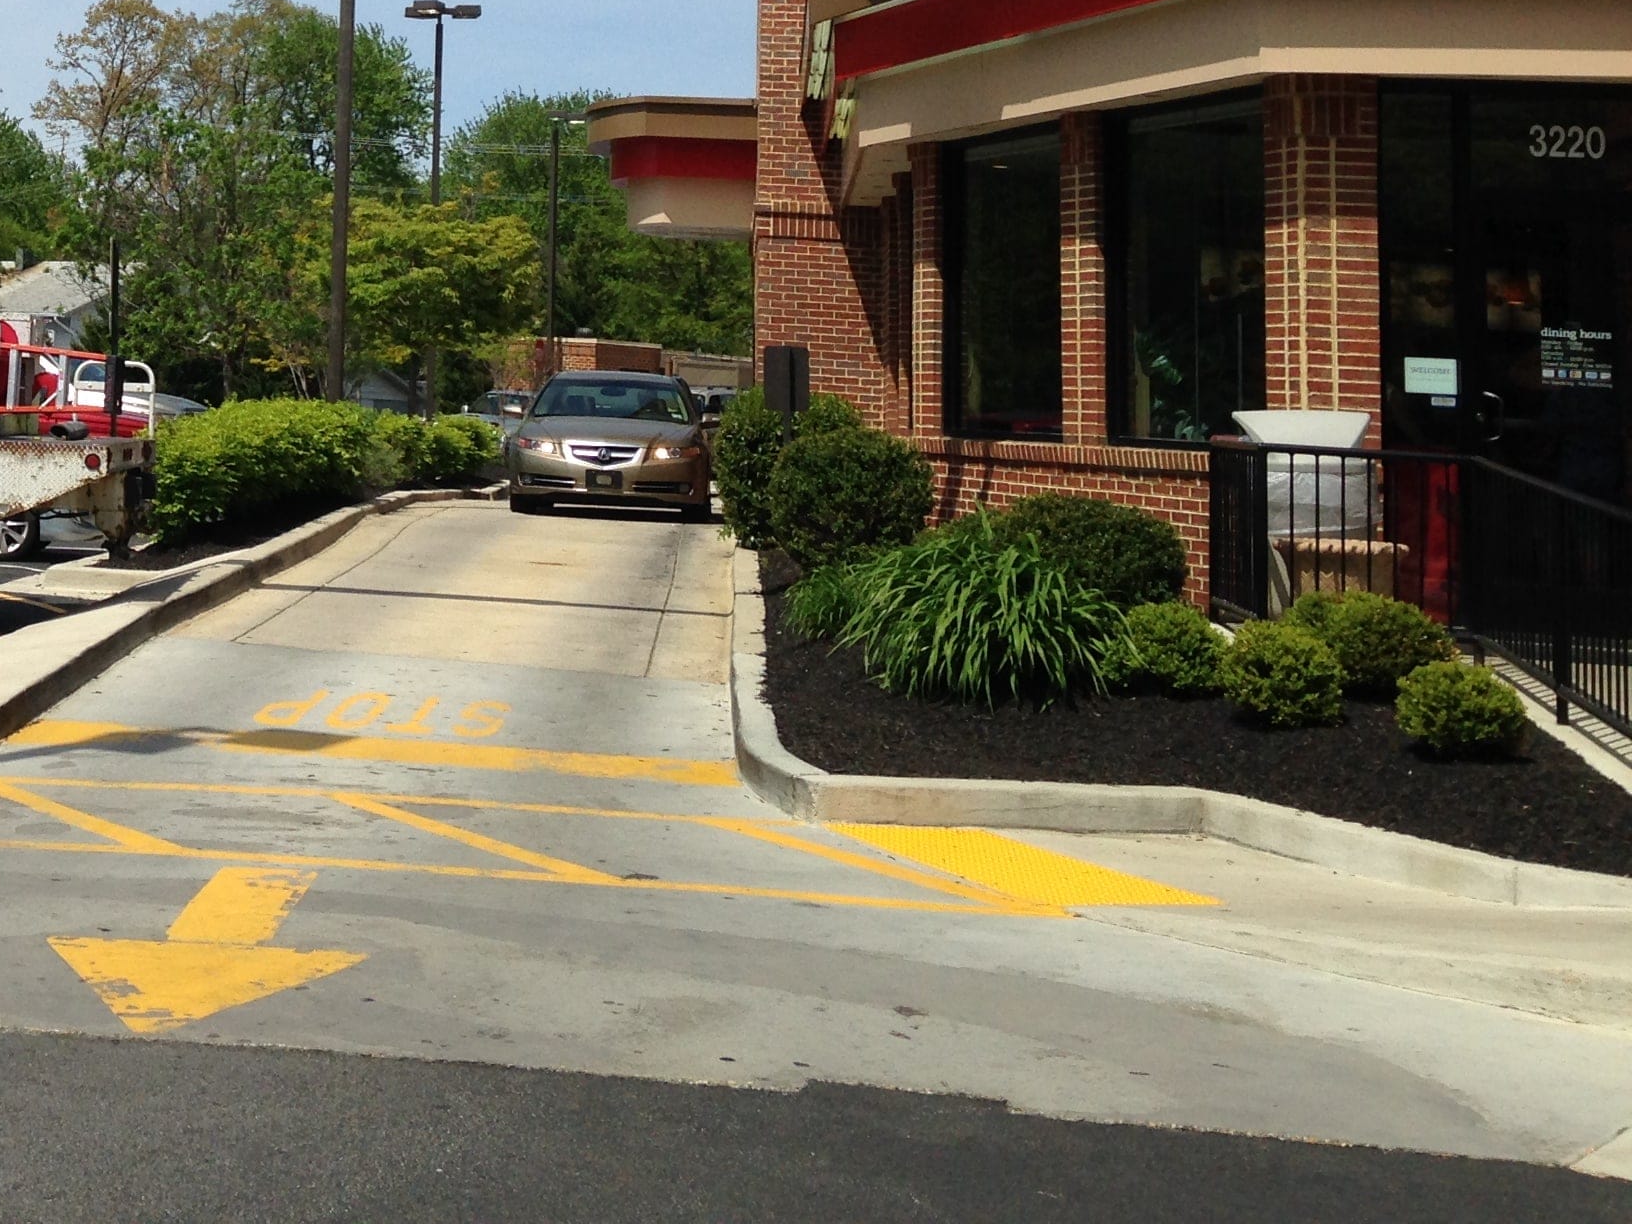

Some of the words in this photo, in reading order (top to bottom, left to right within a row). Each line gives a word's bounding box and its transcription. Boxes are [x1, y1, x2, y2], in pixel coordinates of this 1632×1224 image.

[1528, 124, 1607, 160] 3220
[1540, 327, 1578, 341] dining
[1579, 328, 1612, 340] hours
[252, 688, 513, 738] STOP
